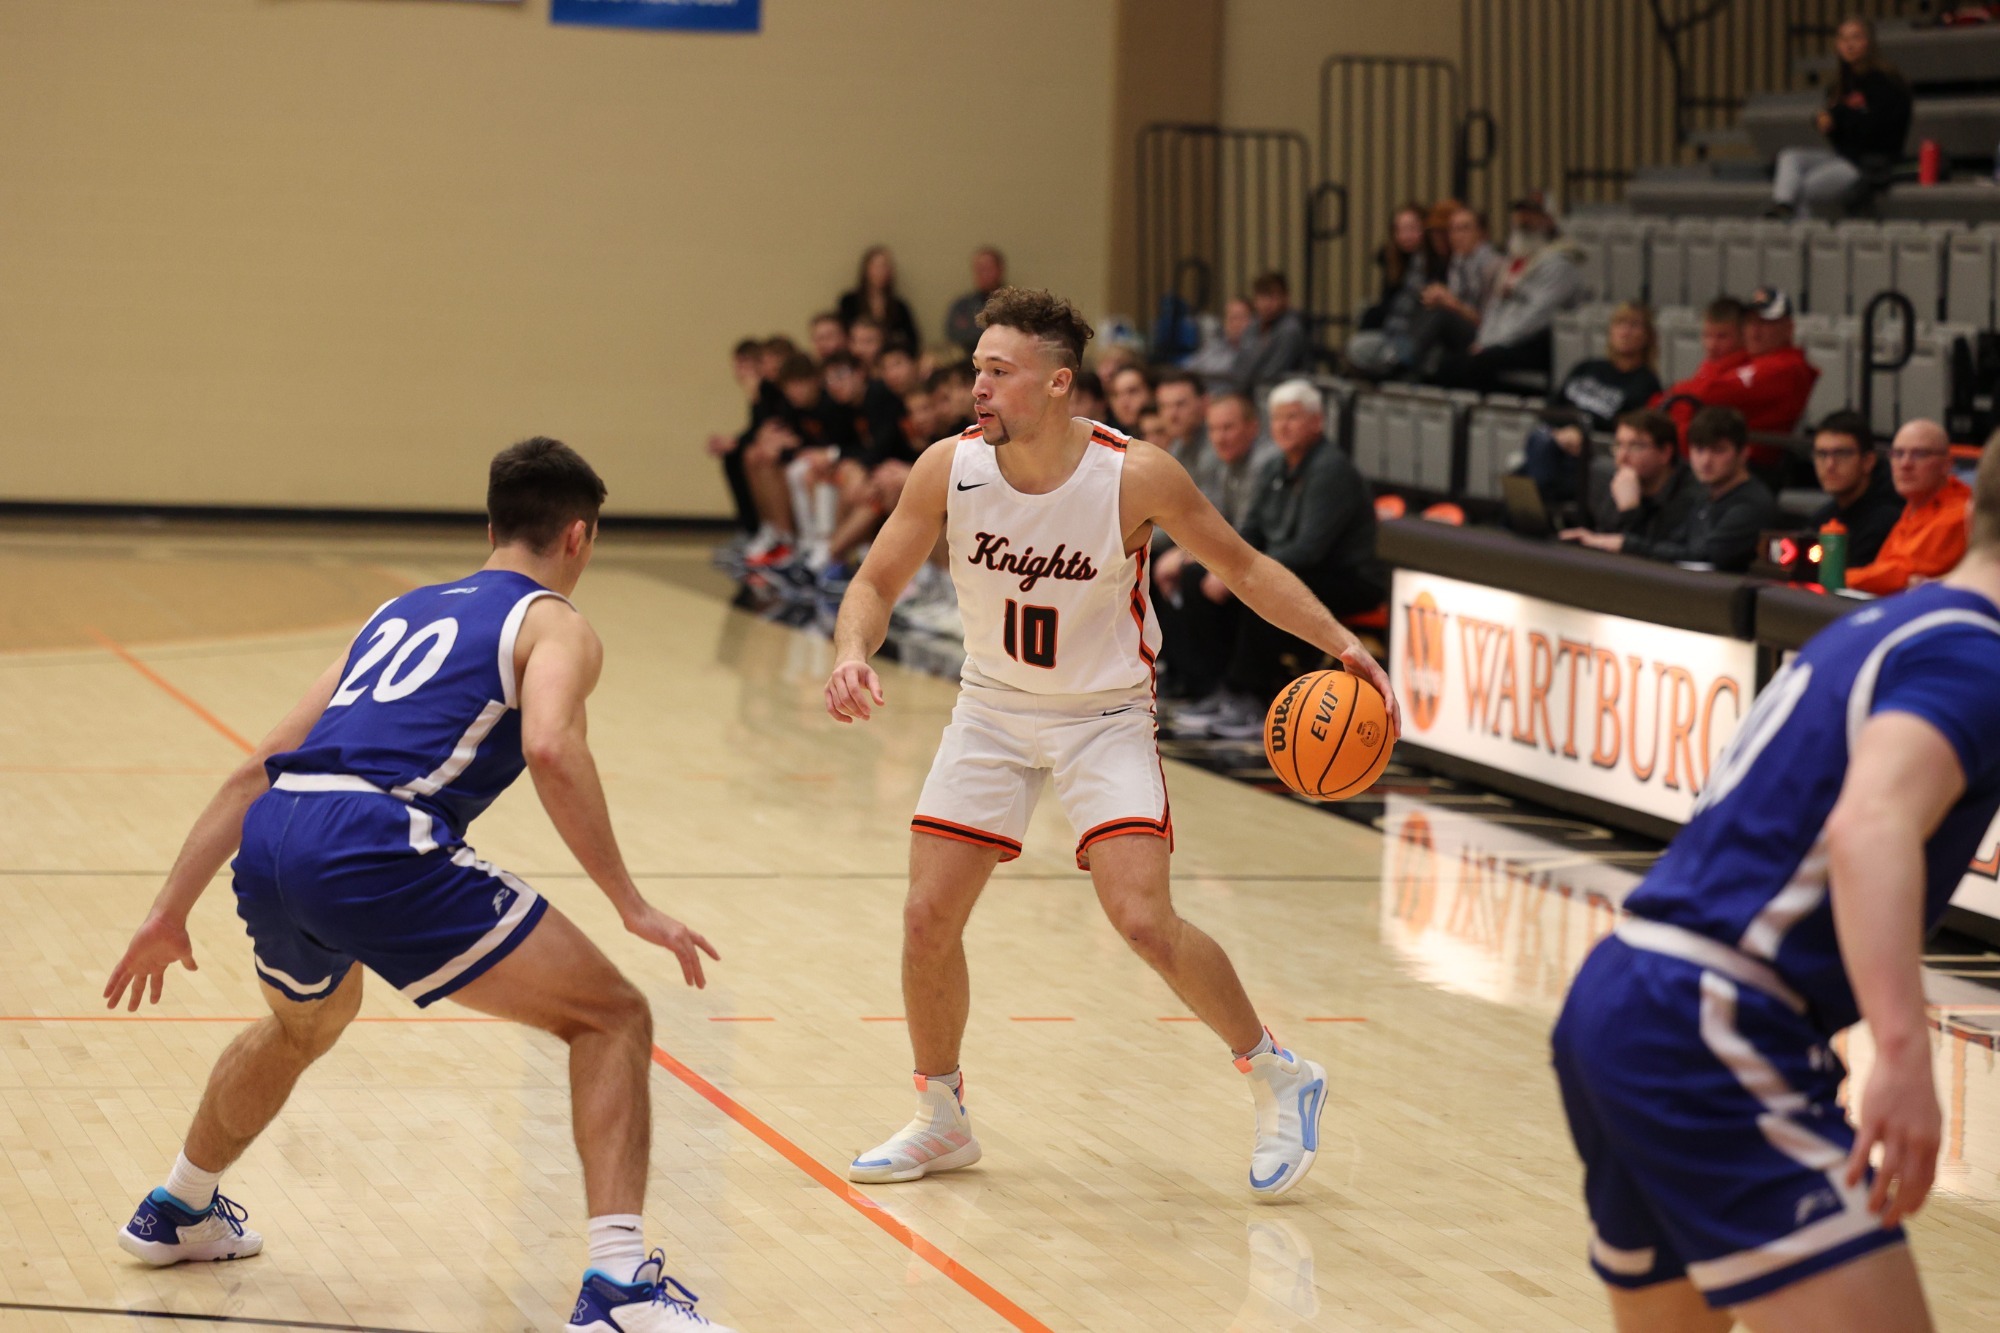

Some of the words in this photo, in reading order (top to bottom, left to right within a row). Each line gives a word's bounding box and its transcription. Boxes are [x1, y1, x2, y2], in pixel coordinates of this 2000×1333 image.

[968, 531, 1098, 593] Knights
[327, 616, 459, 707] 20
[1003, 598, 1059, 670] 10
[1272, 676, 1312, 754] Wilson
